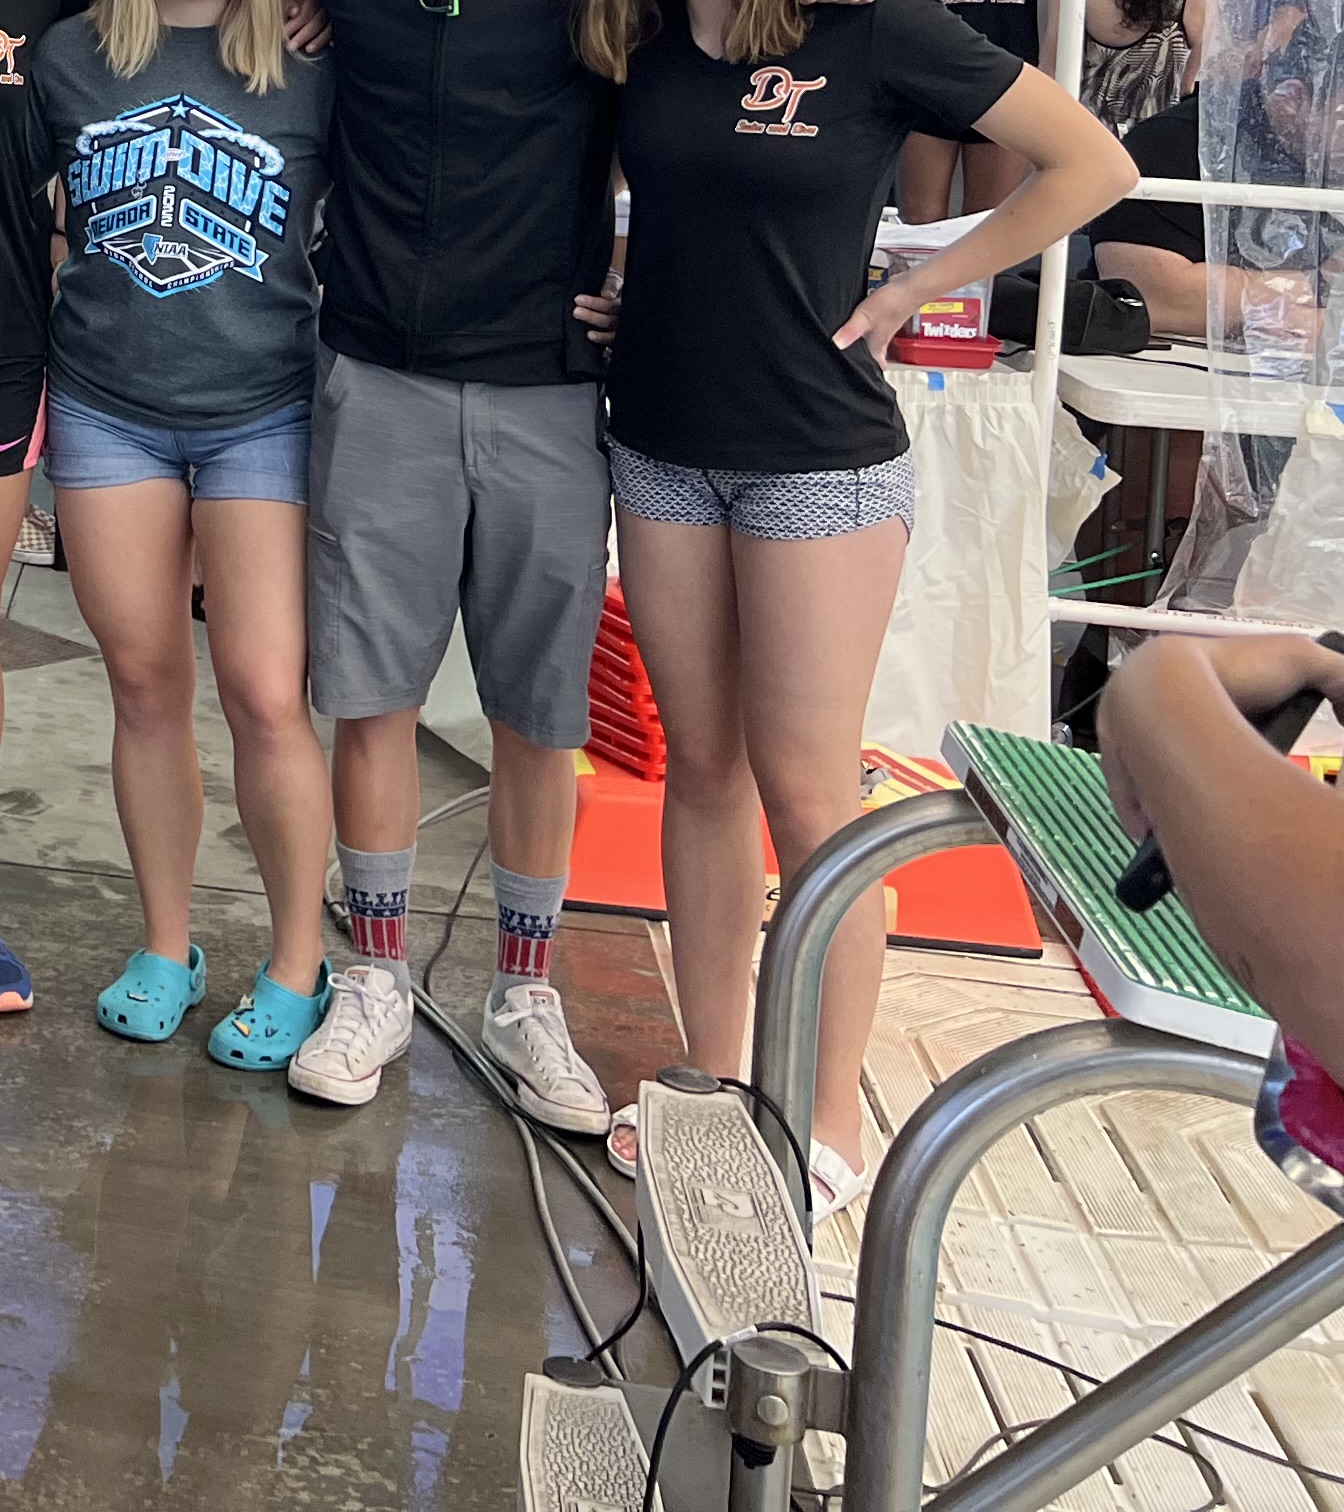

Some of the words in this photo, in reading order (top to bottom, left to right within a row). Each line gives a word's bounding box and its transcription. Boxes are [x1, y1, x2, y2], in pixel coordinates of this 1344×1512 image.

[176, 128, 290, 237] DIVE
[92, 200, 151, 238] NEVADA
[184, 205, 251, 258] STATE
